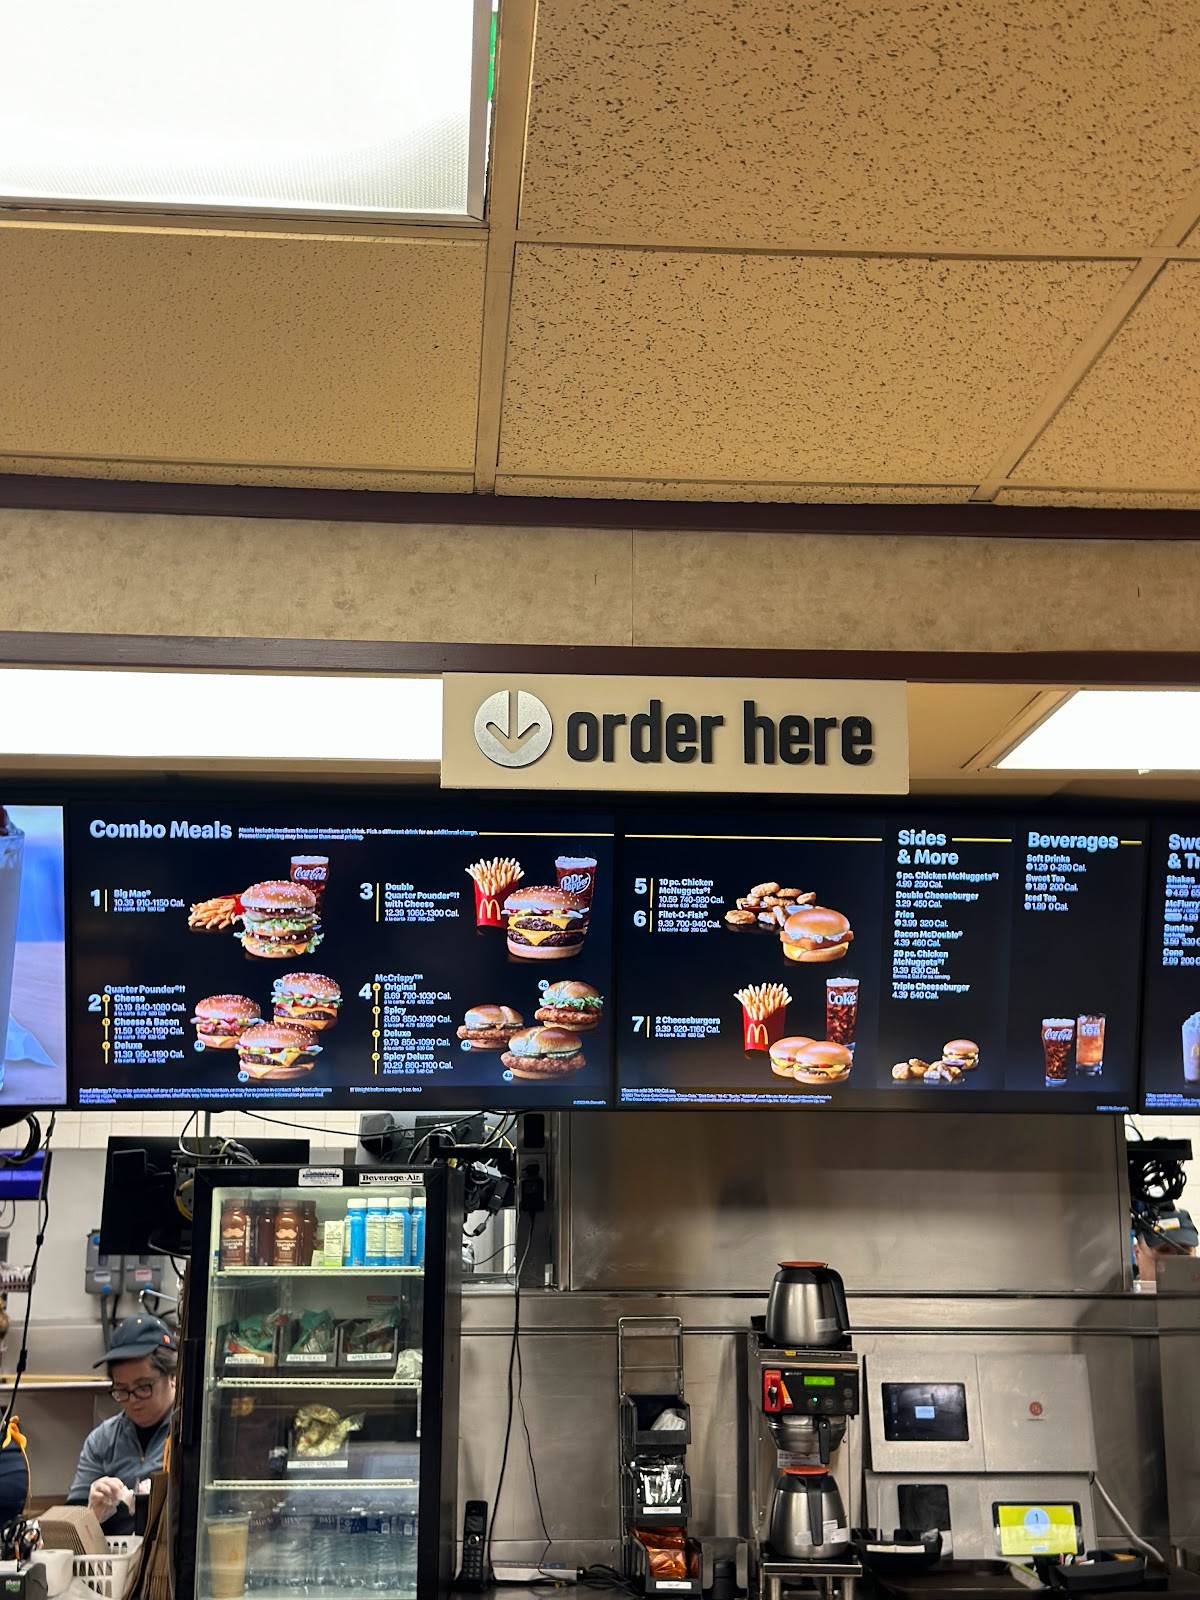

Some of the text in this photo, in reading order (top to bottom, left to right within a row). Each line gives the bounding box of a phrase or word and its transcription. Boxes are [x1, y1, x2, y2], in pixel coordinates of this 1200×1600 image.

[567, 699, 873, 765] order here
[89, 819, 166, 839] Combo
[170, 820, 232, 840] Meals
[898, 829, 946, 846] Sides
[1028, 831, 1118, 852] Beverages
[897, 849, 959, 865] & More
[1026, 854, 1070, 863] Soft Drinks
[1167, 853, 1181, 869] &
[1073, 863, 1087, 872] Cal.
[915, 871, 947, 880] Chicken
[1026, 873, 1065, 883] Sweet Tea
[634, 877, 647, 894] 5
[681, 878, 713, 886] Chicken
[360, 882, 373, 900] 3
[385, 883, 414, 891] Double
[1064, 883, 1078, 892] Cal.
[90, 889, 100, 907] 1
[113, 889, 128, 899] Big
[385, 891, 416, 900] Quarter
[896, 891, 979, 902] Double Cheeseburger
[1025, 894, 1057, 902] Iced Tea
[170, 899, 185, 907] Cal.
[385, 900, 434, 908] with Cheese
[710, 896, 725, 904] Cal.
[928, 900, 942, 908] Cal.
[1055, 902, 1068, 911] Cal.
[445, 909, 460, 917] Cal.
[895, 910, 914, 919] Fries
[633, 910, 646, 927] 6
[707, 920, 721, 928] Cal.
[934, 920, 948, 928] Cal.
[894, 930, 919, 938] Bacon
[927, 939, 941, 947] Cal.
[917, 950, 948, 958] Chicken
[104, 985, 138, 995] Quarter
[358, 983, 372, 1000] 4
[384, 983, 416, 992] Original
[892, 982, 970, 993] Triple Cheeseburger
[114, 994, 145, 1002] Cheese
[437, 992, 451, 1000] Cal.
[829, 991, 856, 1005] Coke
[925, 991, 939, 999] Cal.
[88, 994, 101, 1011] 2
[171, 1003, 186, 1012] Cal.
[384, 1006, 406, 1015] Spicy
[114, 1018, 179, 1026] Cheese & Bacon
[437, 1015, 452, 1023] Cal.
[655, 1016, 720, 1026] 2 Cheeseburgers
[632, 1016, 644, 1032] 7
[170, 1027, 184, 1035] Cal.
[384, 1029, 411, 1037] Deluxe
[114, 1041, 143, 1050] Deluxe
[436, 1038, 450, 1046] Cal.
[170, 1050, 184, 1058] Cal.
[383, 1052, 434, 1061] Spicy Deluxe
[439, 1061, 453, 1069] Cal.
